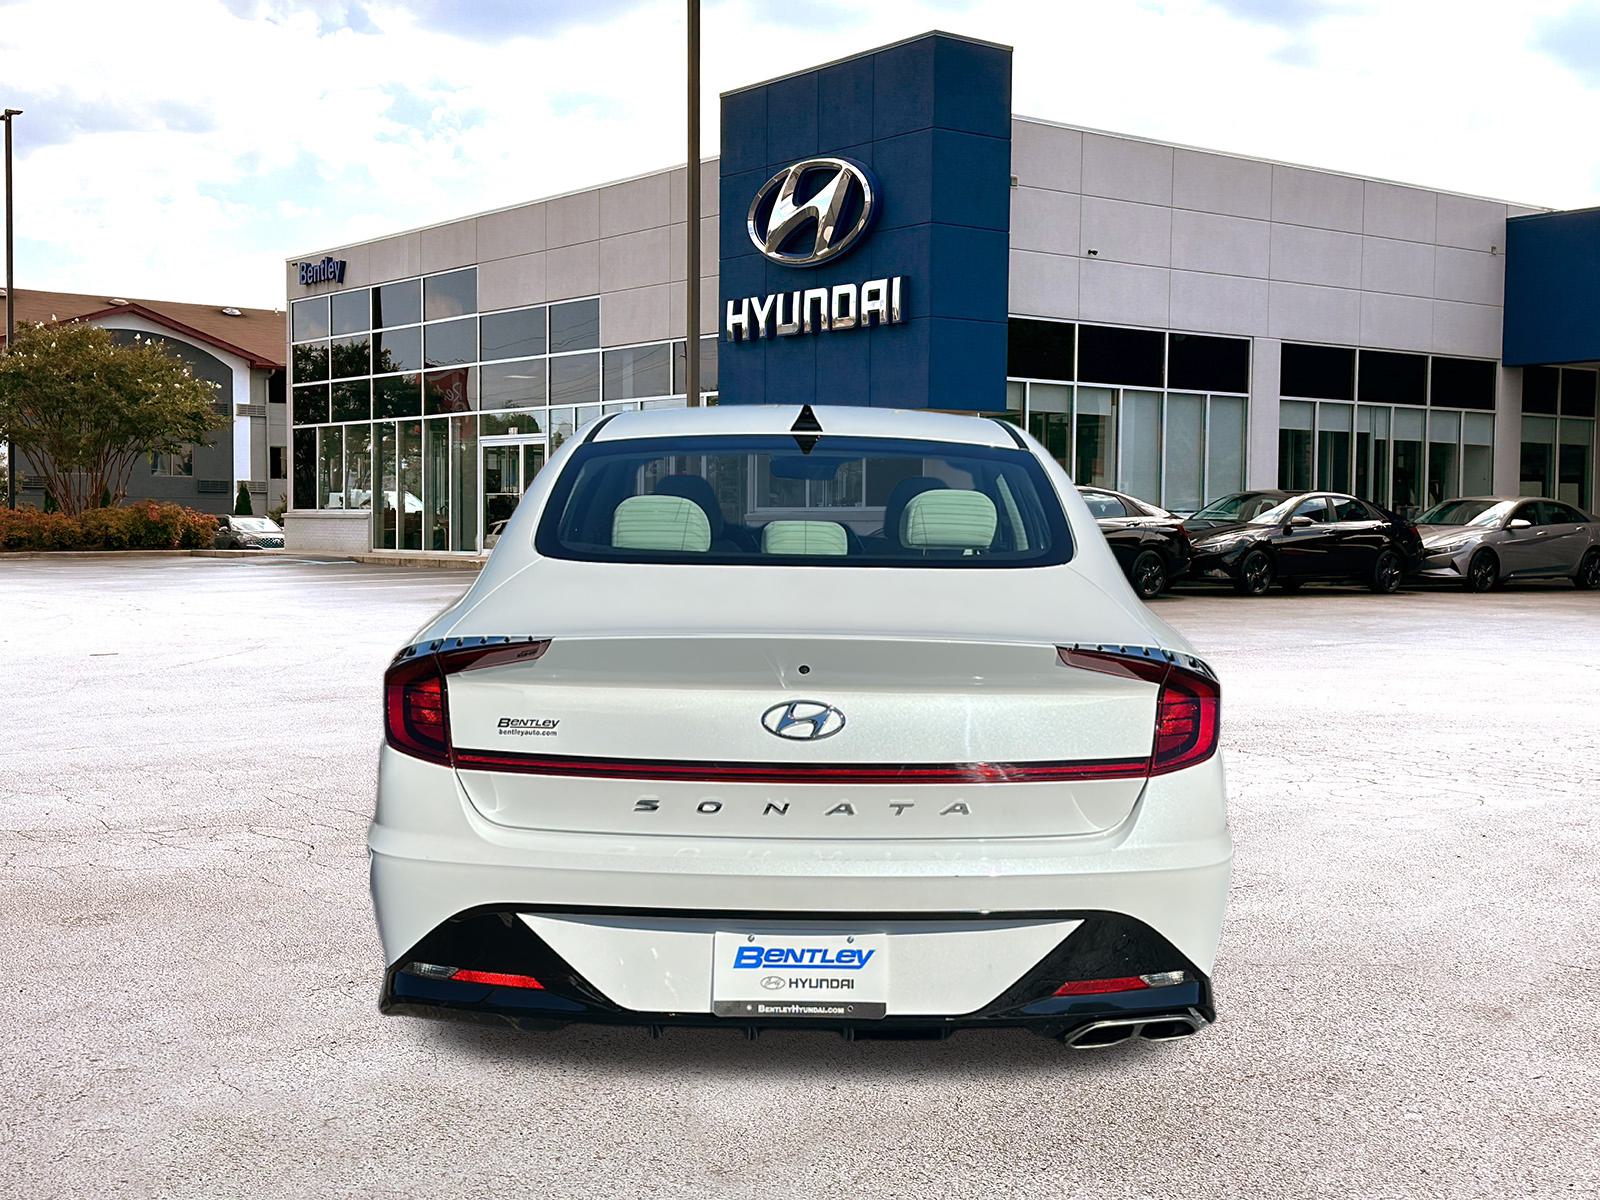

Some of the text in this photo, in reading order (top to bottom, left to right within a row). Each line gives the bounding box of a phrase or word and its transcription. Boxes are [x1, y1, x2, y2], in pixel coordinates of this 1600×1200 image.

[299, 256, 346, 285] Bentley
[726, 276, 905, 342] HYUNDAI
[498, 729, 558, 737] bentleyauto.com
[632, 798, 971, 816] SONATA
[788, 978, 854, 989] HYUNDAI
